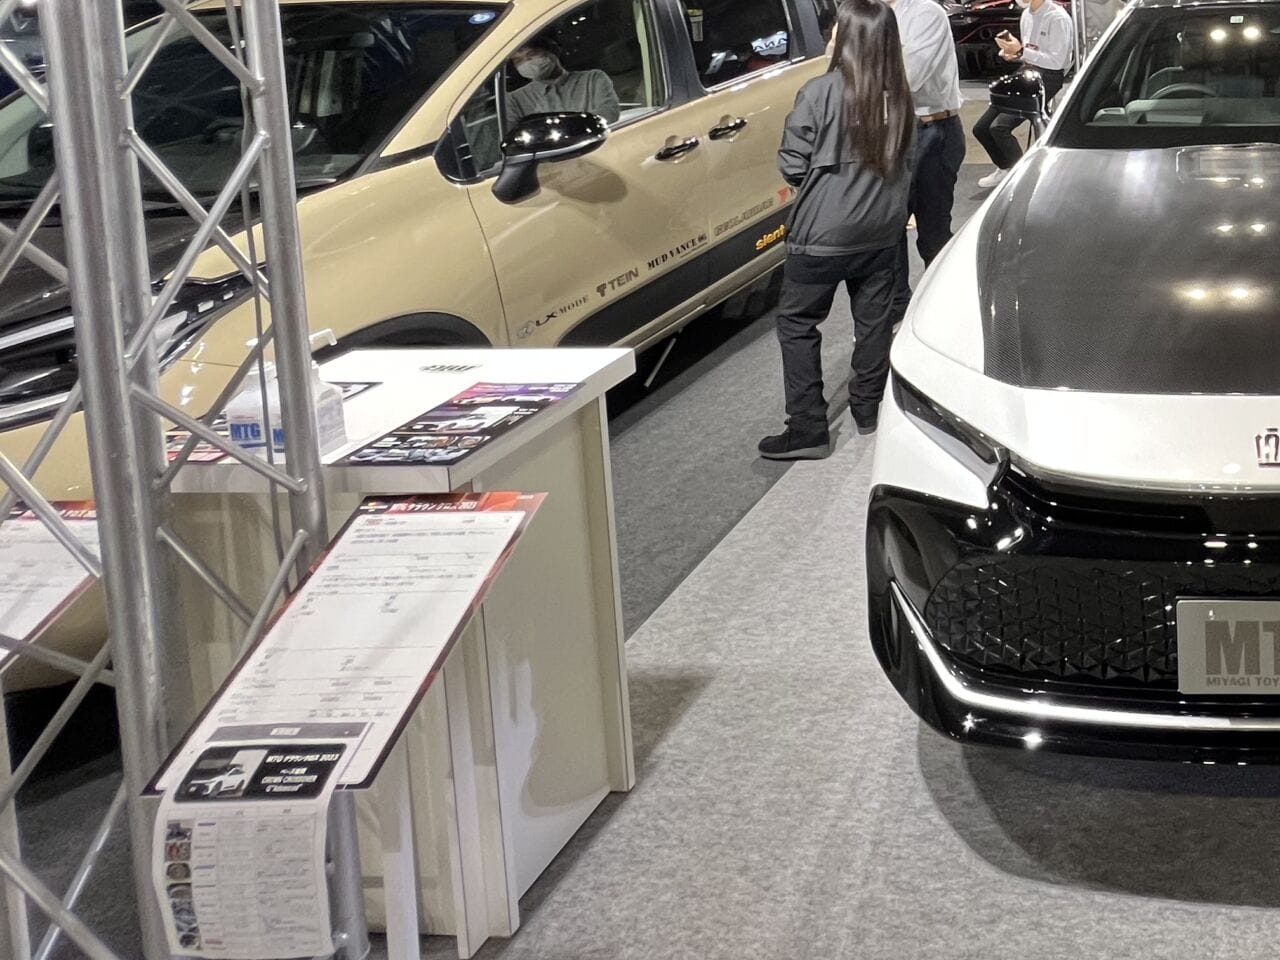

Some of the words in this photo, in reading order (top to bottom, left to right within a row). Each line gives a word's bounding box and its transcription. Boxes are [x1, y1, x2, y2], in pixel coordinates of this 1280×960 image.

[646, 253, 668, 272] MUD
[669, 237, 698, 258] VANCE
[607, 268, 639, 291] TEIN
[230, 423, 262, 442] MTG
[1206, 677, 1250, 688] MIYAGI
